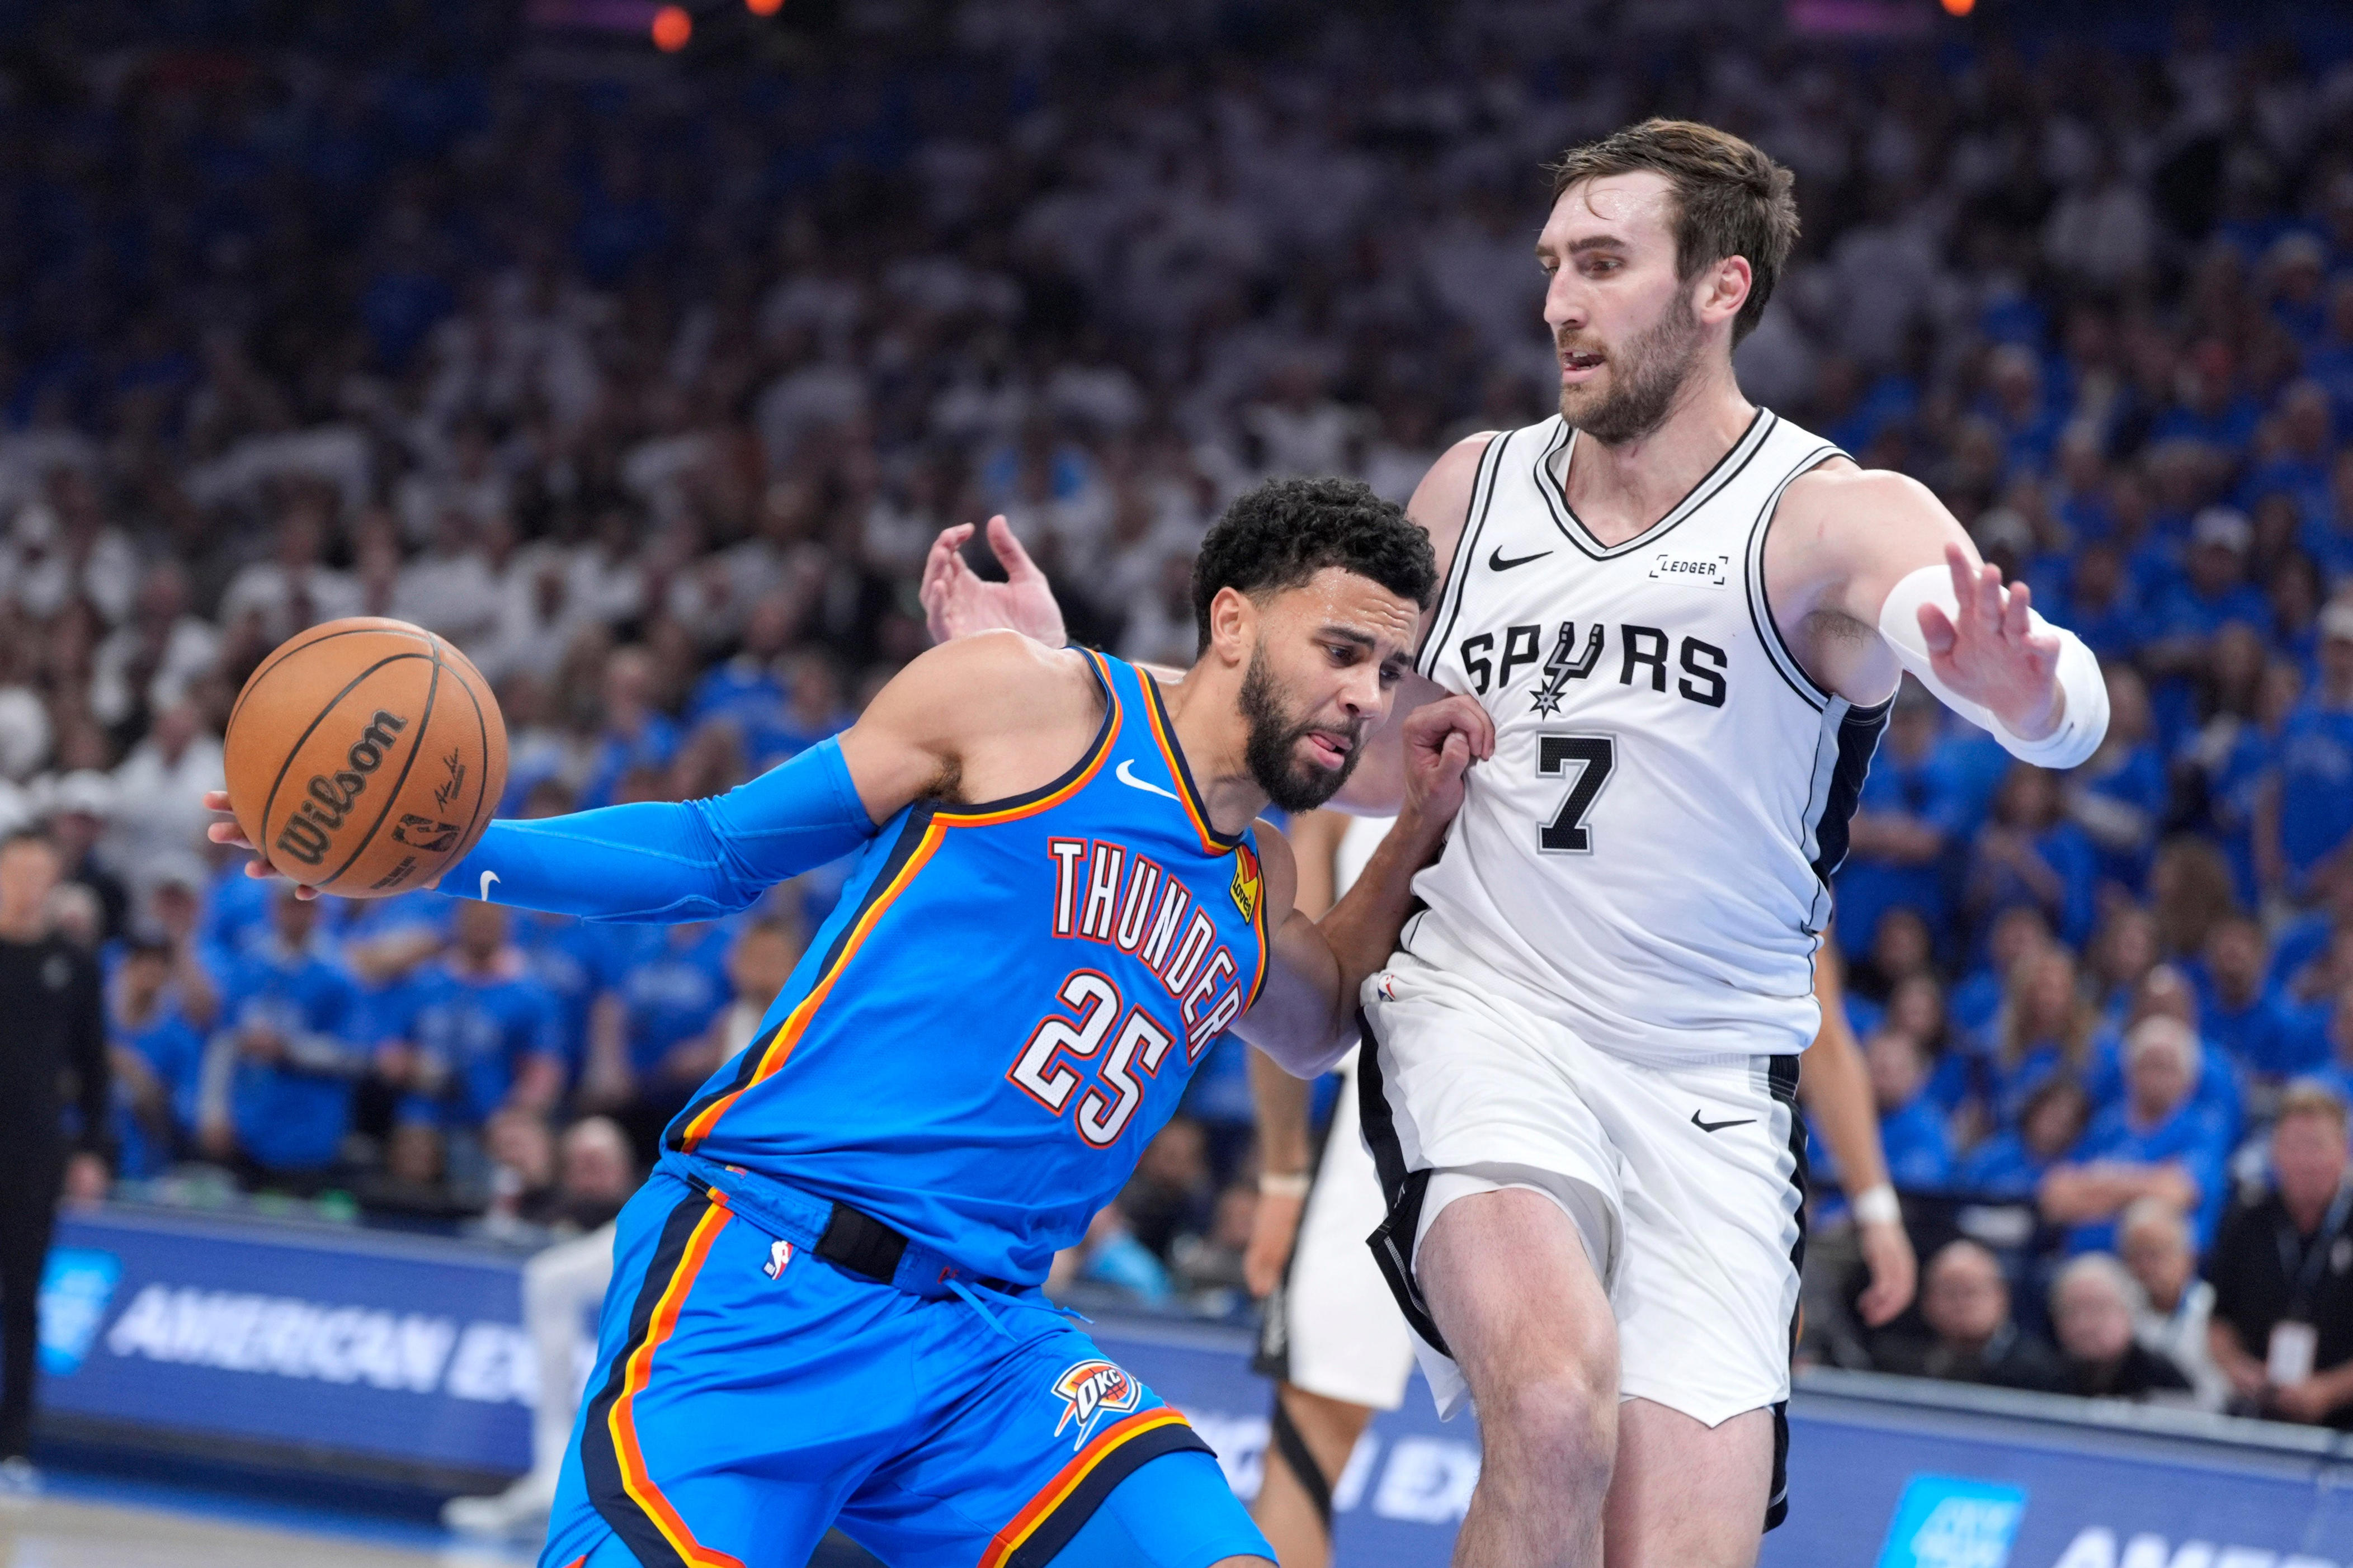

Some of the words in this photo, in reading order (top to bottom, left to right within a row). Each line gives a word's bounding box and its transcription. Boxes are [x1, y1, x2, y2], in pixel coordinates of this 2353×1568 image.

[1661, 561, 1717, 575] LEDGER
[1460, 621, 1728, 722] SPURS
[276, 710, 408, 865] Wilson
[1536, 731, 1618, 856] 7
[1047, 835, 1243, 1066] THUNDER
[1005, 968, 1177, 1150] 25
[1076, 1368, 1122, 1424] OKC
